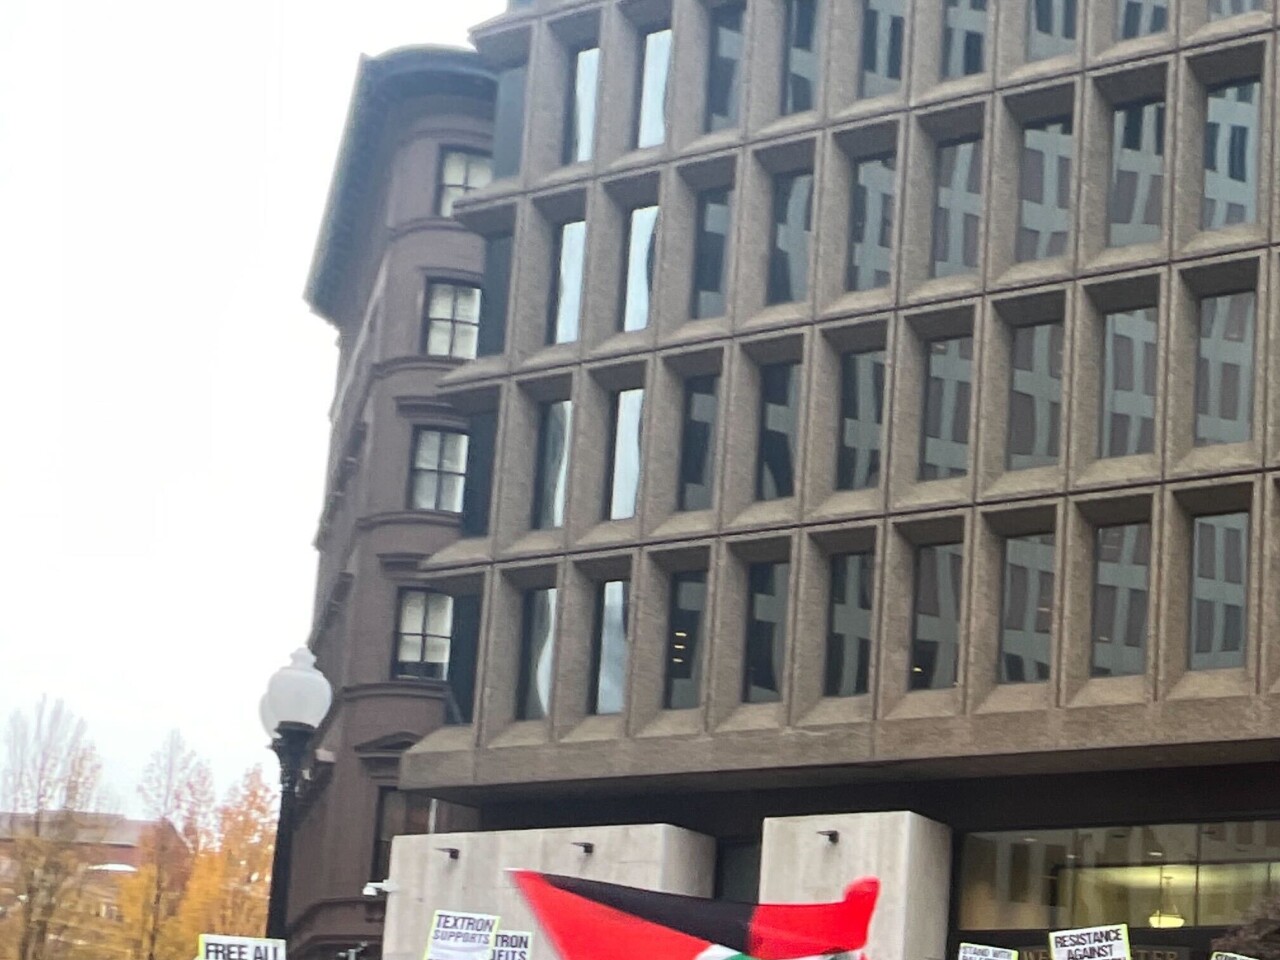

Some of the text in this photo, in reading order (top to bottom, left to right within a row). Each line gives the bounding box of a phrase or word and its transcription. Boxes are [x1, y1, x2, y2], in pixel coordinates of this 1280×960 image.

[437, 914, 496, 932] TEXTRON
[432, 929, 490, 945] SUPPORTS
[495, 934, 529, 949] TRON
[1054, 929, 1122, 948] RESISTANCE
[206, 943, 247, 960] FREE
